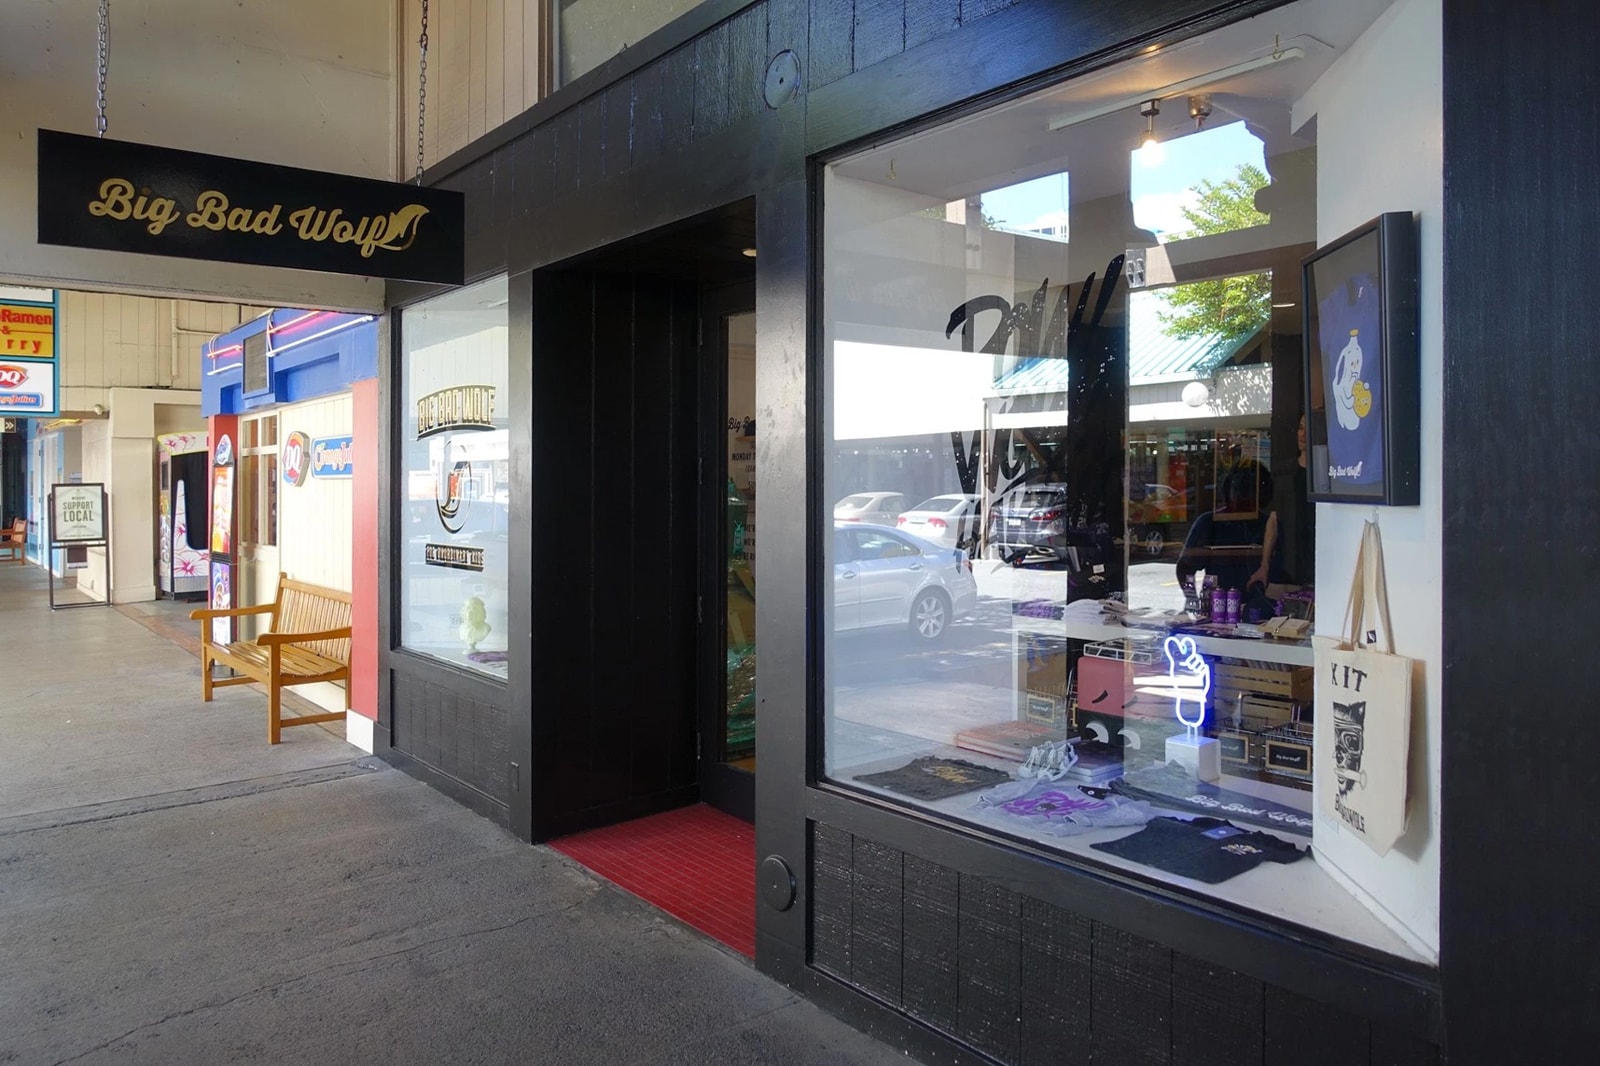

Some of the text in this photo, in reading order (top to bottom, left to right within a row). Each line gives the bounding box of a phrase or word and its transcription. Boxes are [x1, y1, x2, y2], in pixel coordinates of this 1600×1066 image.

[89, 177, 429, 258] Big Bad Wolf
[0, 309, 52, 325] Ramen
[1, 326, 10, 335] &
[417, 386, 496, 434] BIG BAD WOLF
[63, 501, 94, 510] SUPPORT
[63, 510, 94, 522] LOCAL
